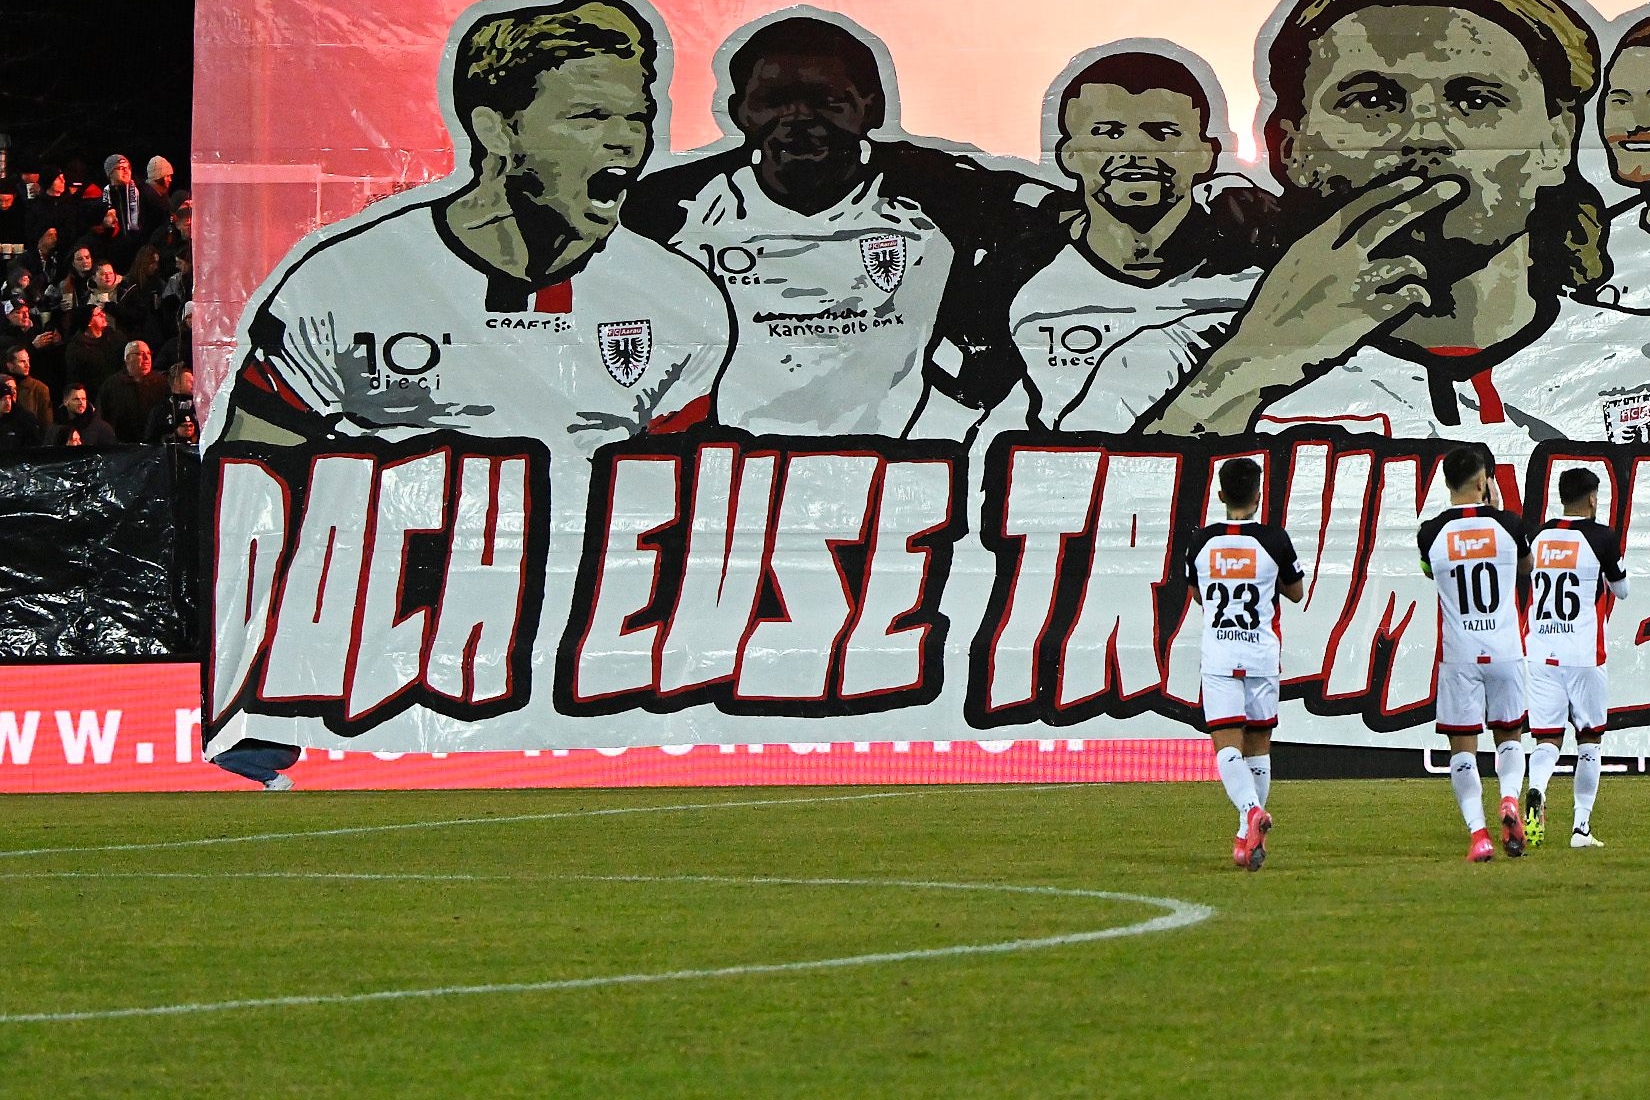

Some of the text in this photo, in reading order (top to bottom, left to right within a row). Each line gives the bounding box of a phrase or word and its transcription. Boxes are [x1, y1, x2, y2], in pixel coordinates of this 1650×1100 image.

[728, 273, 761, 286] eci
[485, 318, 552, 330] CRAFT
[369, 368, 442, 391] dieci
[1453, 533, 1491, 558] hrs
[1540, 543, 1574, 566] hrs
[1215, 551, 1251, 576] hrs
[201, 445, 534, 728] DOCH
[573, 441, 955, 702] EUSE
[1450, 561, 1500, 615] 10
[1534, 571, 1581, 622] 26
[1205, 582, 1261, 631] 23
[1463, 619, 1496, 632] FAZLIU
